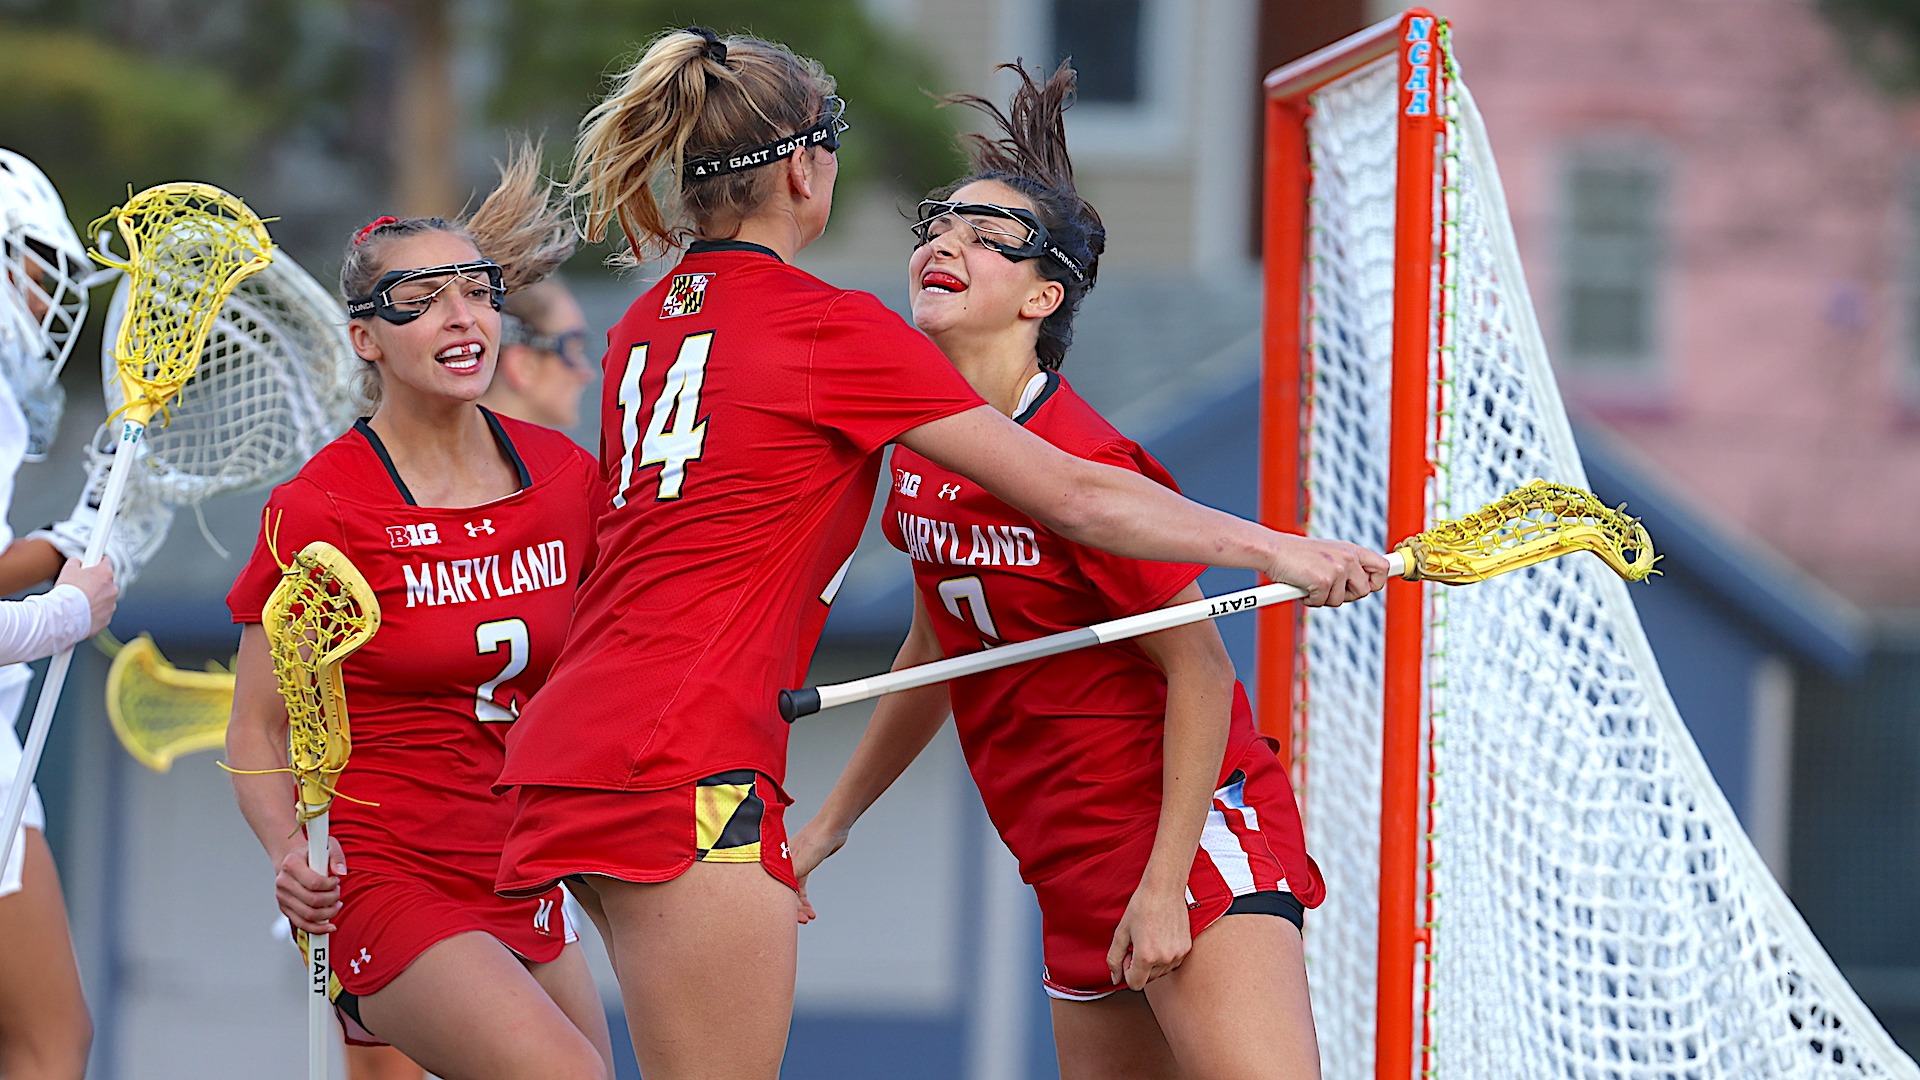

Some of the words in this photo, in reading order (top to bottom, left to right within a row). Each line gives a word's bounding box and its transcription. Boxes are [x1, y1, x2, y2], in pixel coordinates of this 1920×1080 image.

[1404, 16, 1434, 116] NCAA
[729, 149, 769, 169] GAIT
[776, 135, 807, 156] GAIT
[812, 128, 828, 143] GA
[612, 329, 716, 509] 14
[897, 510, 1041, 567] MARYLAND
[402, 539, 567, 608] MARYLAND
[1208, 595, 1257, 617] GAIT
[474, 616, 530, 724] 2
[313, 947, 326, 997] GAIT
